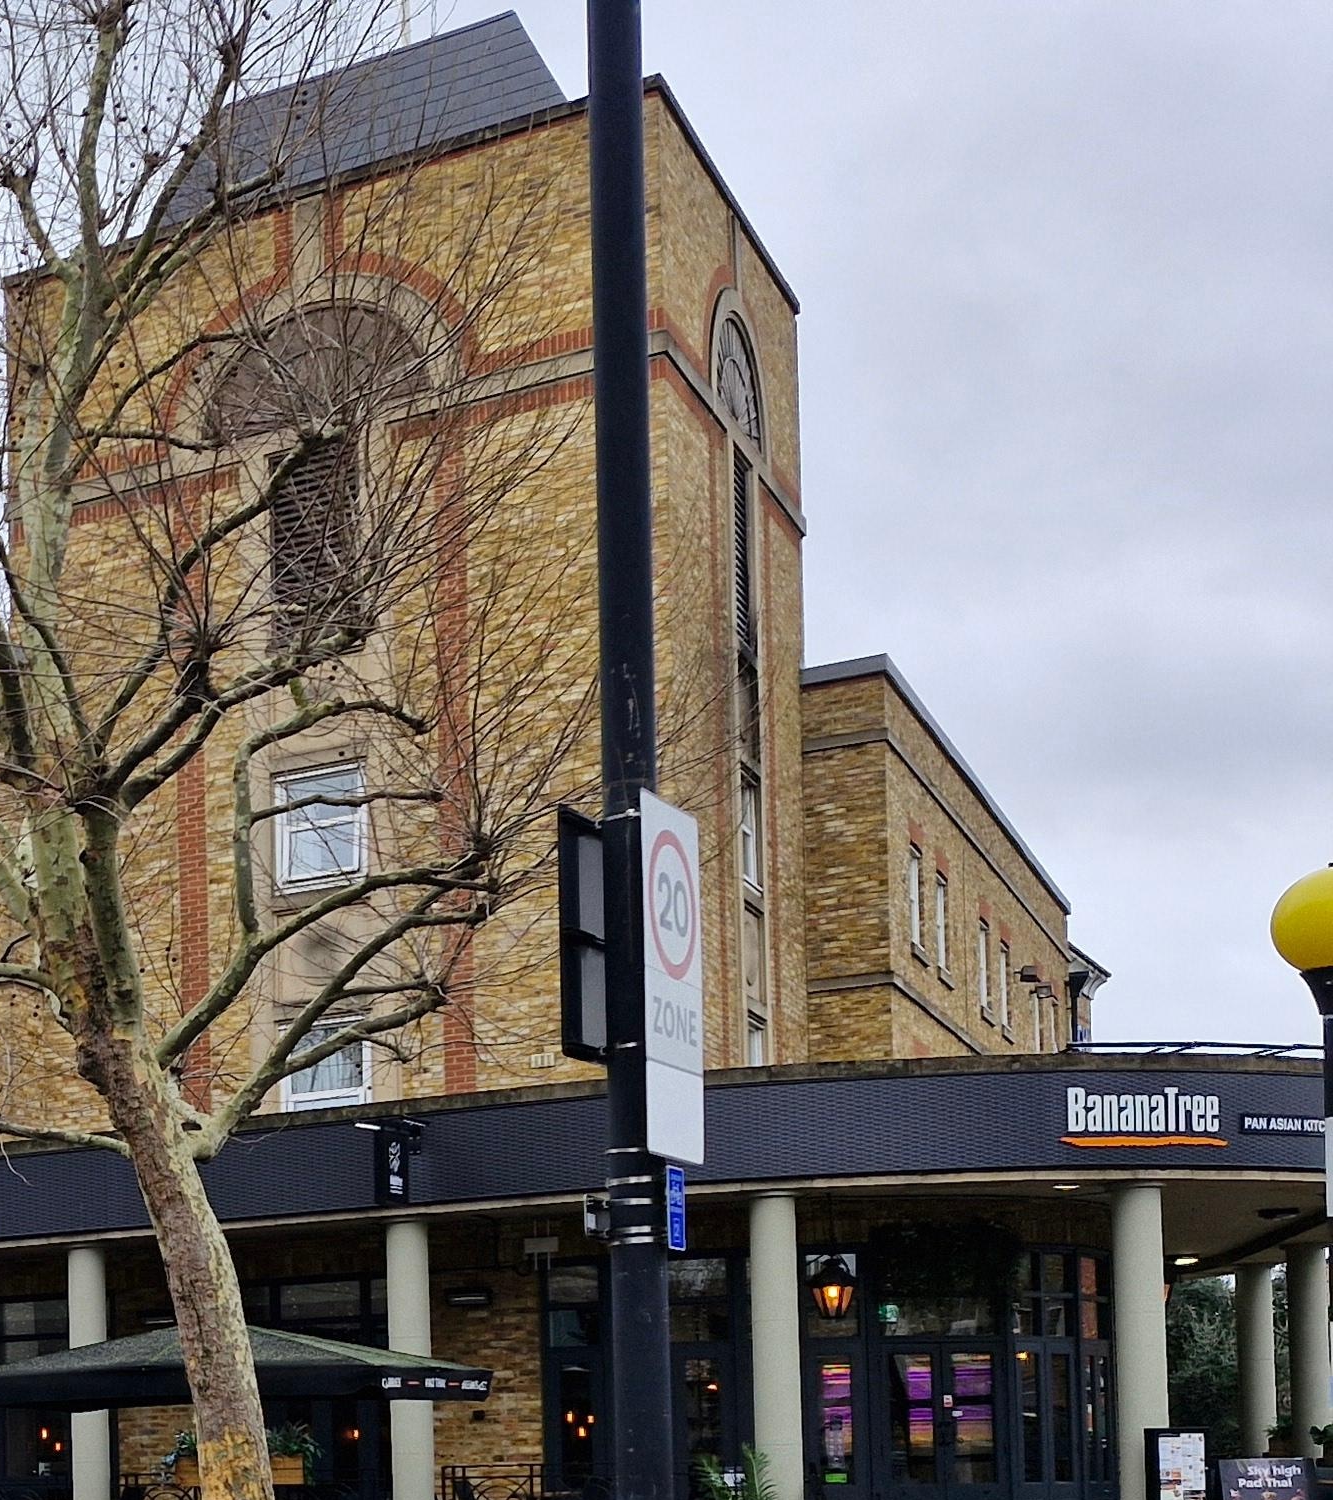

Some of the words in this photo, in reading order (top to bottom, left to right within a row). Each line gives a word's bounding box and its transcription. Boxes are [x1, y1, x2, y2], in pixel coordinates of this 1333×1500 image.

[658, 871, 688, 938] 20
[653, 996, 697, 1047] ZONE
[1067, 1087, 1220, 1132] BananaTree
[1244, 1116, 1268, 1129] PAN
[1269, 1117, 1302, 1131] ASIAN
[1303, 1119, 1326, 1133] KITC
[1238, 1478, 1264, 1488] Pad
[1265, 1477, 1293, 1488] Thai
[1247, 1465, 1270, 1479] Sky
[1272, 1464, 1302, 1479] high
